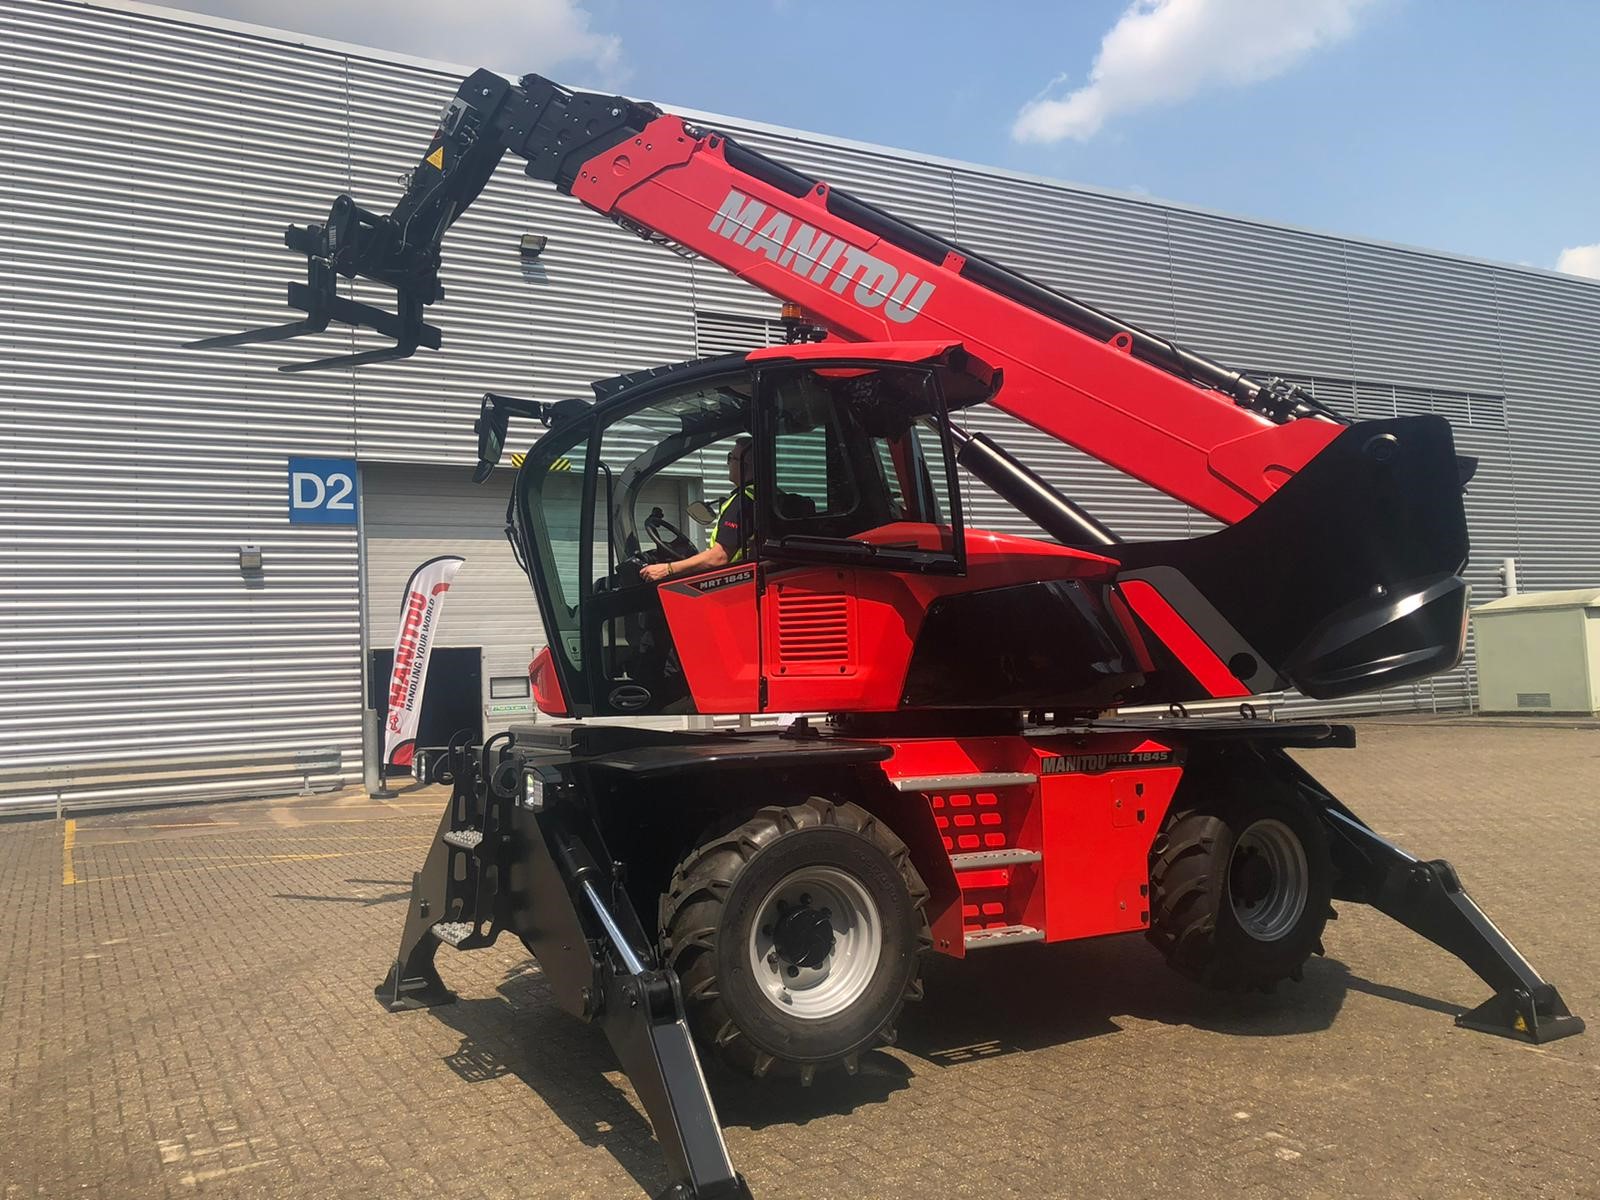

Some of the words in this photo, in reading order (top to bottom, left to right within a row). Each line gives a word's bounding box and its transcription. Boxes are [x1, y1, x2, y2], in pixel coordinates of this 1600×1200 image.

[707, 189, 937, 324] MANITOU
[292, 472, 354, 510] D2
[700, 579, 721, 589] MRT
[725, 572, 750, 583] 1845
[390, 591, 427, 708] MANITOU
[406, 661, 422, 711] HANDLING
[416, 634, 428, 659] YOUR
[422, 598, 434, 632] WORLD
[1043, 755, 1106, 773] MANITOU
[1107, 753, 1135, 763] MRT
[1137, 752, 1168, 761] 1845
